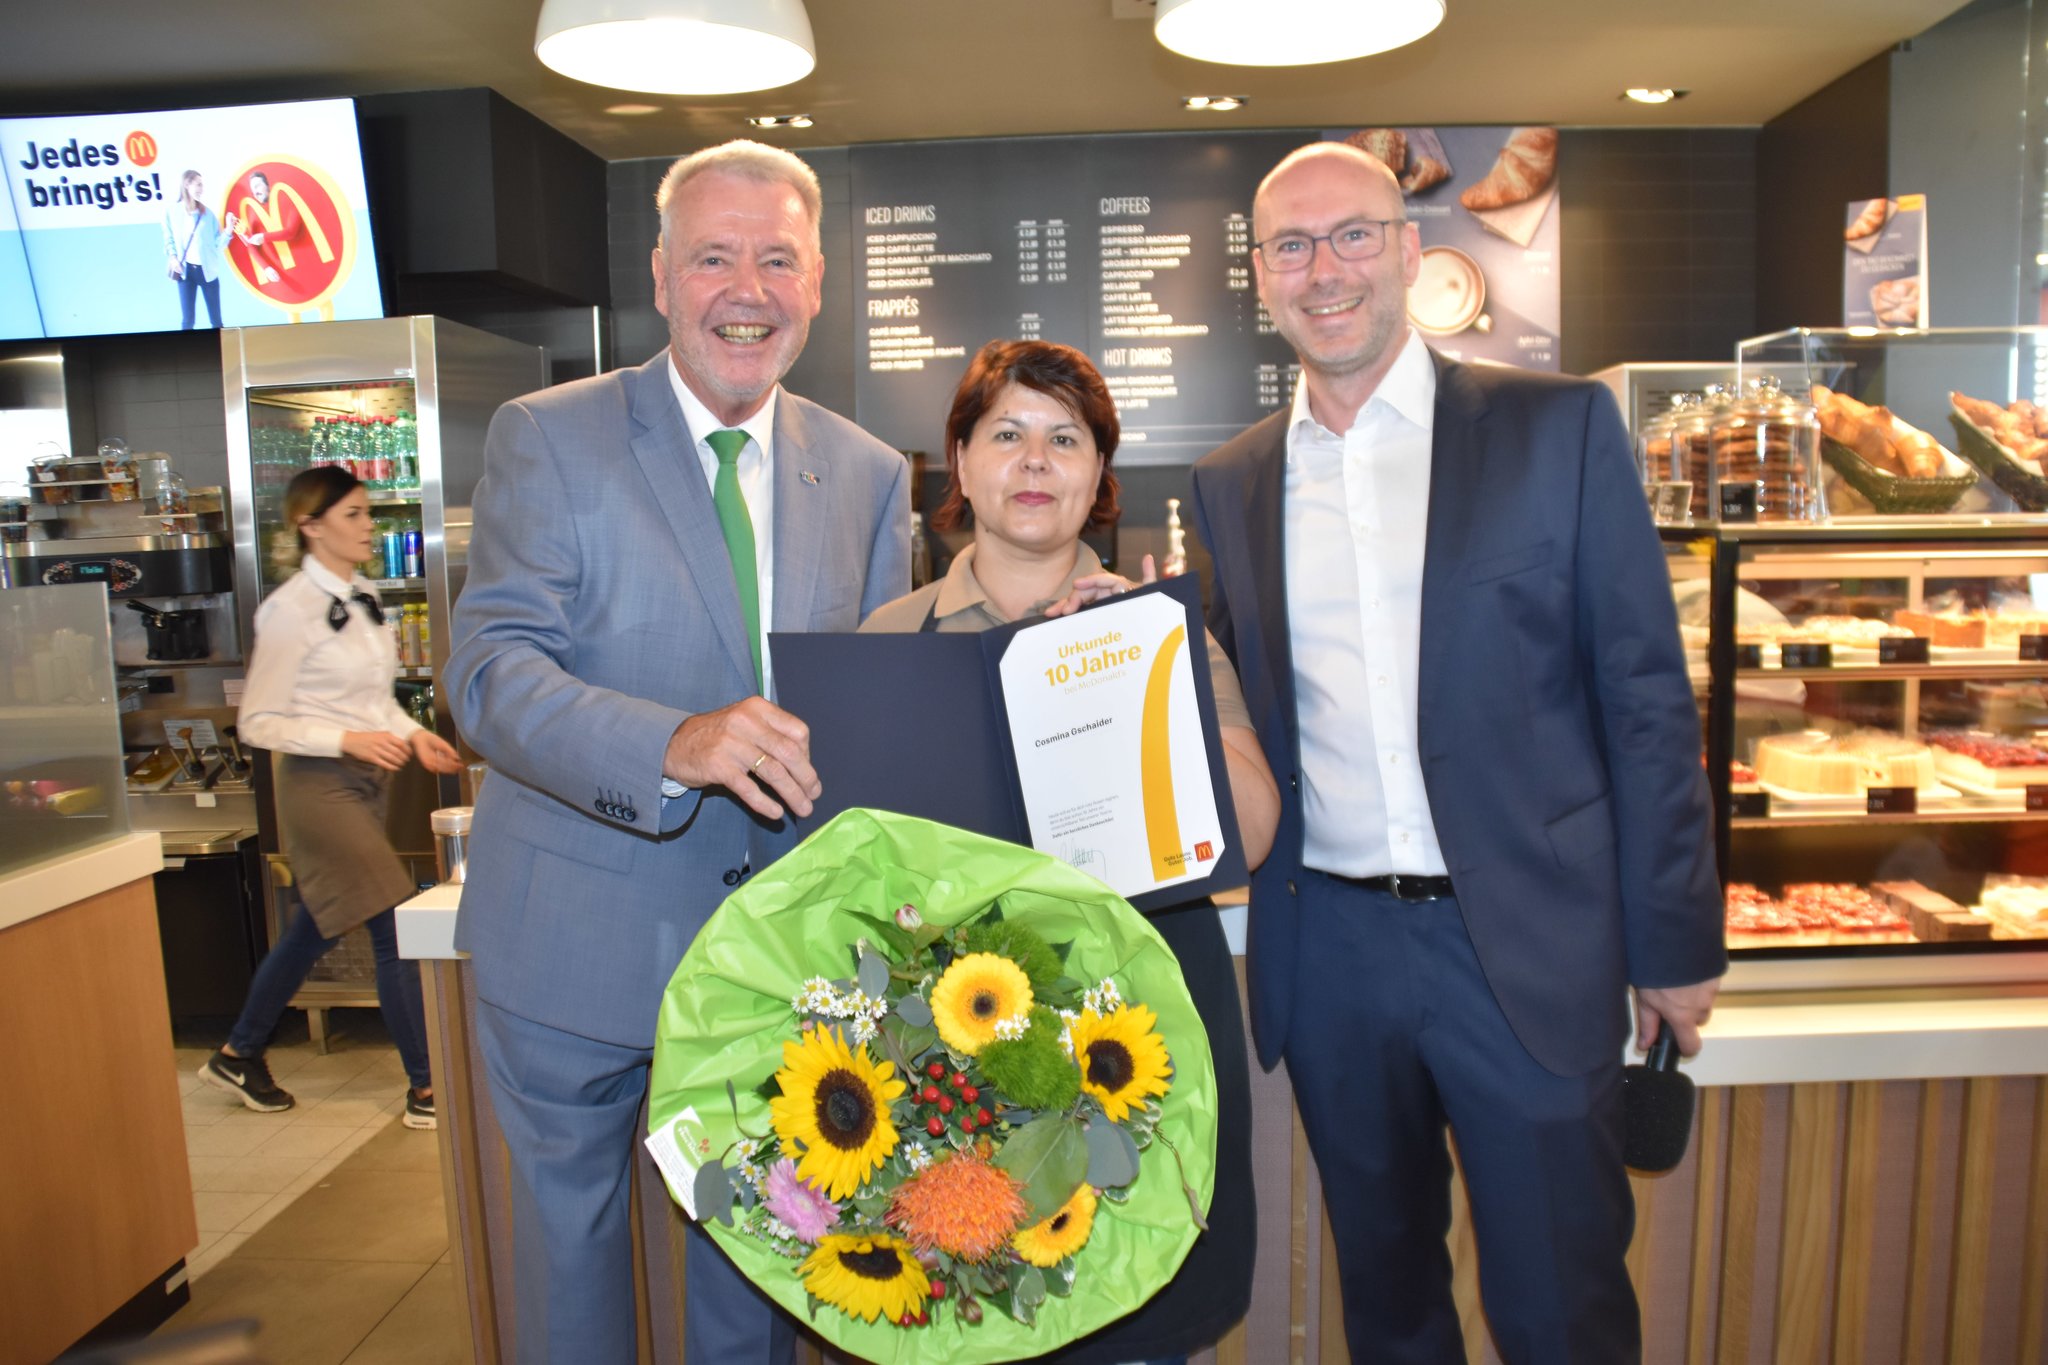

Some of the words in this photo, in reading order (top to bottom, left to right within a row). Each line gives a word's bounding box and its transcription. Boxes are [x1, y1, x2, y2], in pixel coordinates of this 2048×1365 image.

[20, 138, 120, 170] Jedes
[25, 172, 163, 210] bringt's!
[1100, 197, 1150, 215] COFFEES
[866, 206, 892, 224] ICED
[894, 204, 936, 223] DRINKS
[1101, 225, 1144, 235] ESPRESSO
[866, 234, 885, 243] ICED
[886, 232, 937, 242] CAPPUCCINO
[1101, 236, 1144, 246] ESPRESSO
[1145, 234, 1190, 245] MACCHIATO
[866, 246, 886, 255] ICED
[912, 243, 935, 253] LATTE
[867, 257, 886, 266] ICED
[887, 255, 922, 265] CARAMEL
[923, 254, 946, 263] LATTE
[947, 252, 992, 262] MACCHIATO
[1102, 259, 1140, 269] GROSSER
[867, 268, 887, 278] ICED
[887, 267, 906, 277] CHAI
[906, 266, 930, 276] LATTE
[1103, 270, 1154, 280] CAPPUCCINO
[867, 280, 887, 289] ICED
[887, 278, 934, 288] CHOCOLATE
[1103, 282, 1140, 292] MELANGE
[1129, 292, 1151, 302] LATTE
[868, 295, 919, 318] FRAPPÉS
[1104, 304, 1134, 314] VANILLA
[1135, 303, 1158, 313] LATTE
[1104, 316, 1126, 326] LATTE
[1104, 327, 1140, 337] CARAMEL
[1104, 349, 1127, 367] HOT
[1129, 347, 1173, 367] DRINKS
[1058, 631, 1122, 659] Urkunde
[1045, 663, 1070, 687] 10
[1074, 645, 1142, 678] Jahre
[1064, 683, 1077, 695] bei
[1078, 670, 1127, 690] McDonald's
[1035, 731, 1070, 748] Cosmina
[1071, 717, 1113, 736] Gschaider
